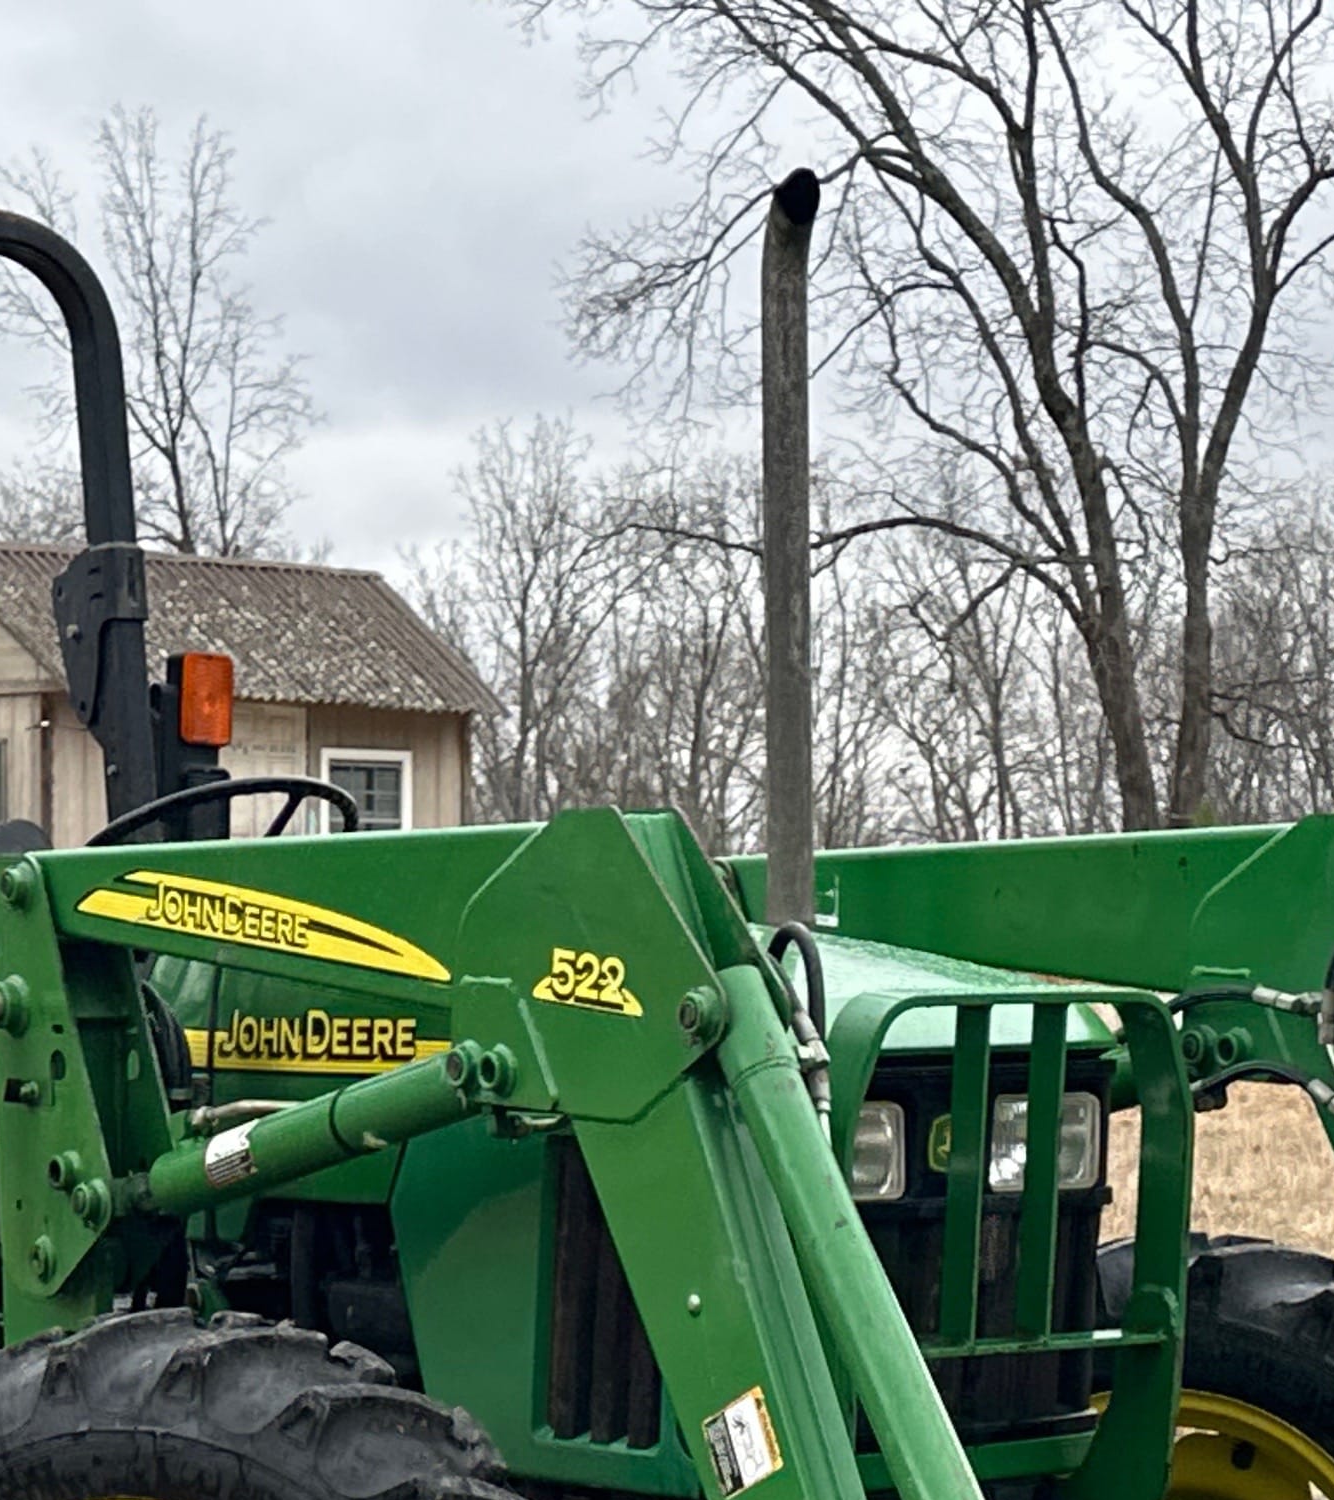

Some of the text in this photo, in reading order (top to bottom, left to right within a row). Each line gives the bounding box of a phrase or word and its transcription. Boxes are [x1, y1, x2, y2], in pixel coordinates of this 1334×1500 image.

[147, 881, 309, 947] JOHN DEERE
[551, 947, 625, 1008] 522
[220, 1009, 416, 1059] JOHN DEERE
